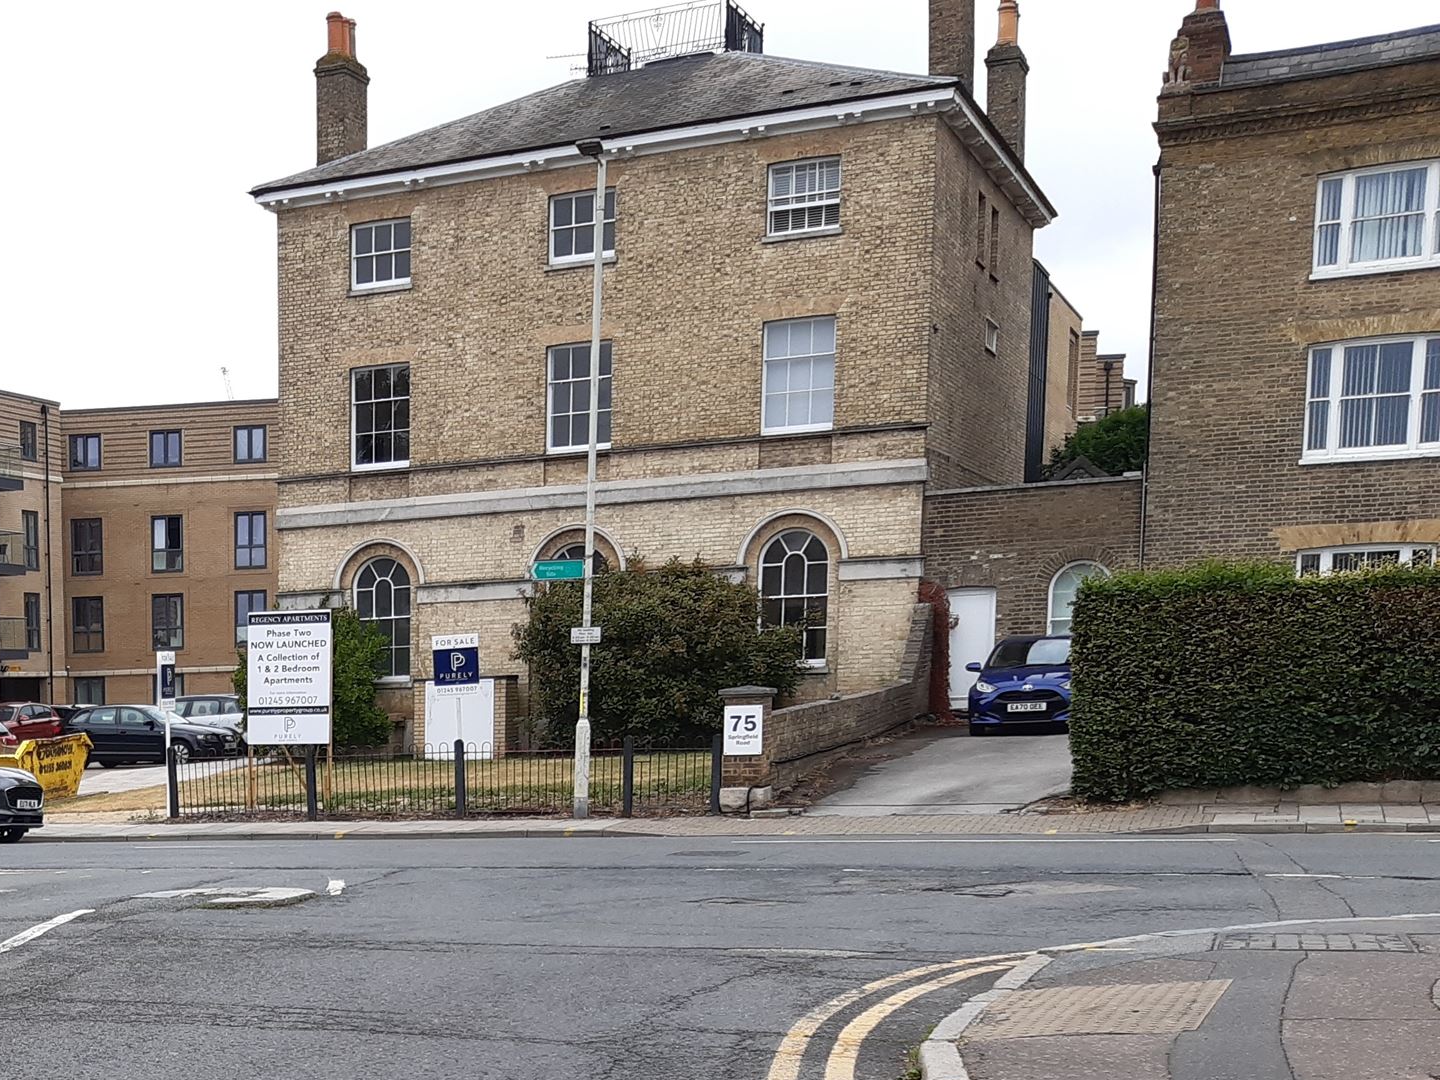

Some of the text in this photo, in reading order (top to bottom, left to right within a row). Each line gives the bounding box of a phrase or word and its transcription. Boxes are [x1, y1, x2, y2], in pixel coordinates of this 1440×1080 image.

[251, 616, 281, 624] REGENCY
[251, 640, 327, 649] NOW LAUNCHED
[454, 637, 475, 645] SALE
[257, 652, 320, 662] A Collection of
[265, 665, 270, 673] &
[264, 676, 313, 686] Apartments
[258, 696, 318, 705] 01245 967007
[730, 715, 756, 732] 75
